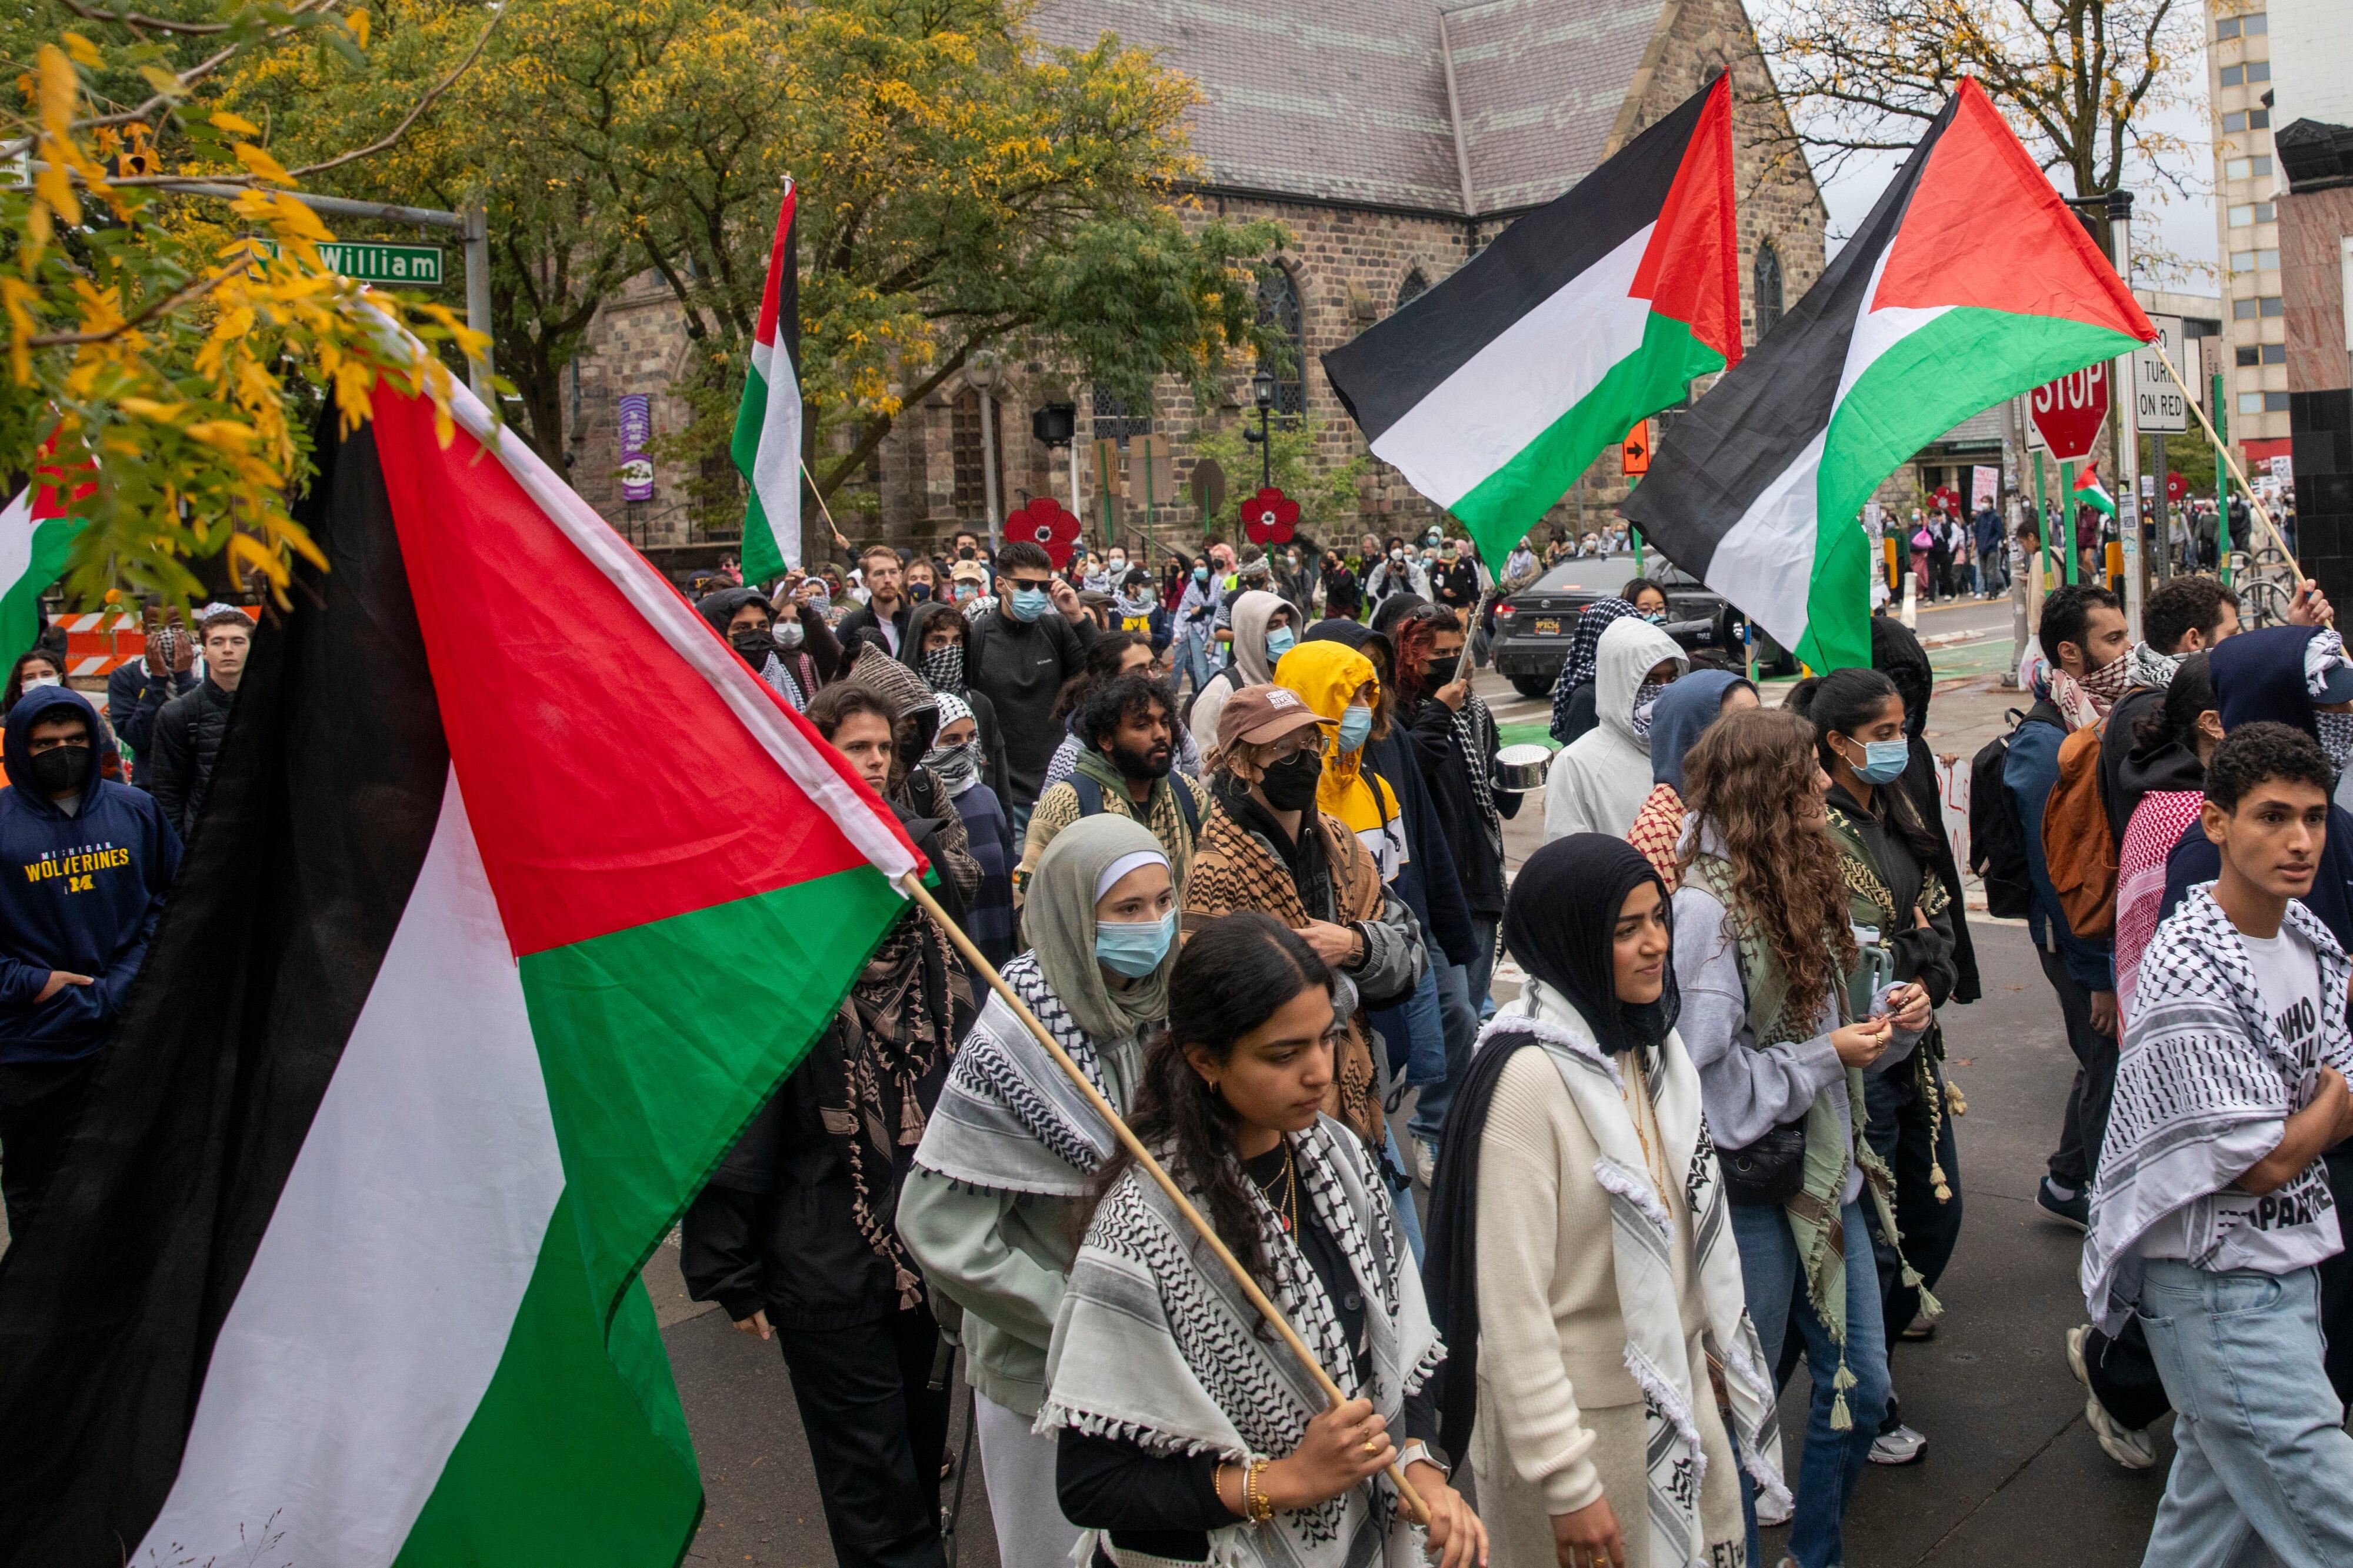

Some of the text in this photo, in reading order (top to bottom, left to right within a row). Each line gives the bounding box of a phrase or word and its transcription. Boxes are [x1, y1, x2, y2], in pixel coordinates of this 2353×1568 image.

[320, 246, 435, 278] William
[2035, 361, 2102, 413] STOP
[2144, 361, 2175, 383] TURN
[2140, 393, 2182, 416] ON RED
[24, 848, 131, 882] WOLVERINES
[2275, 996, 2315, 1046] WHO
